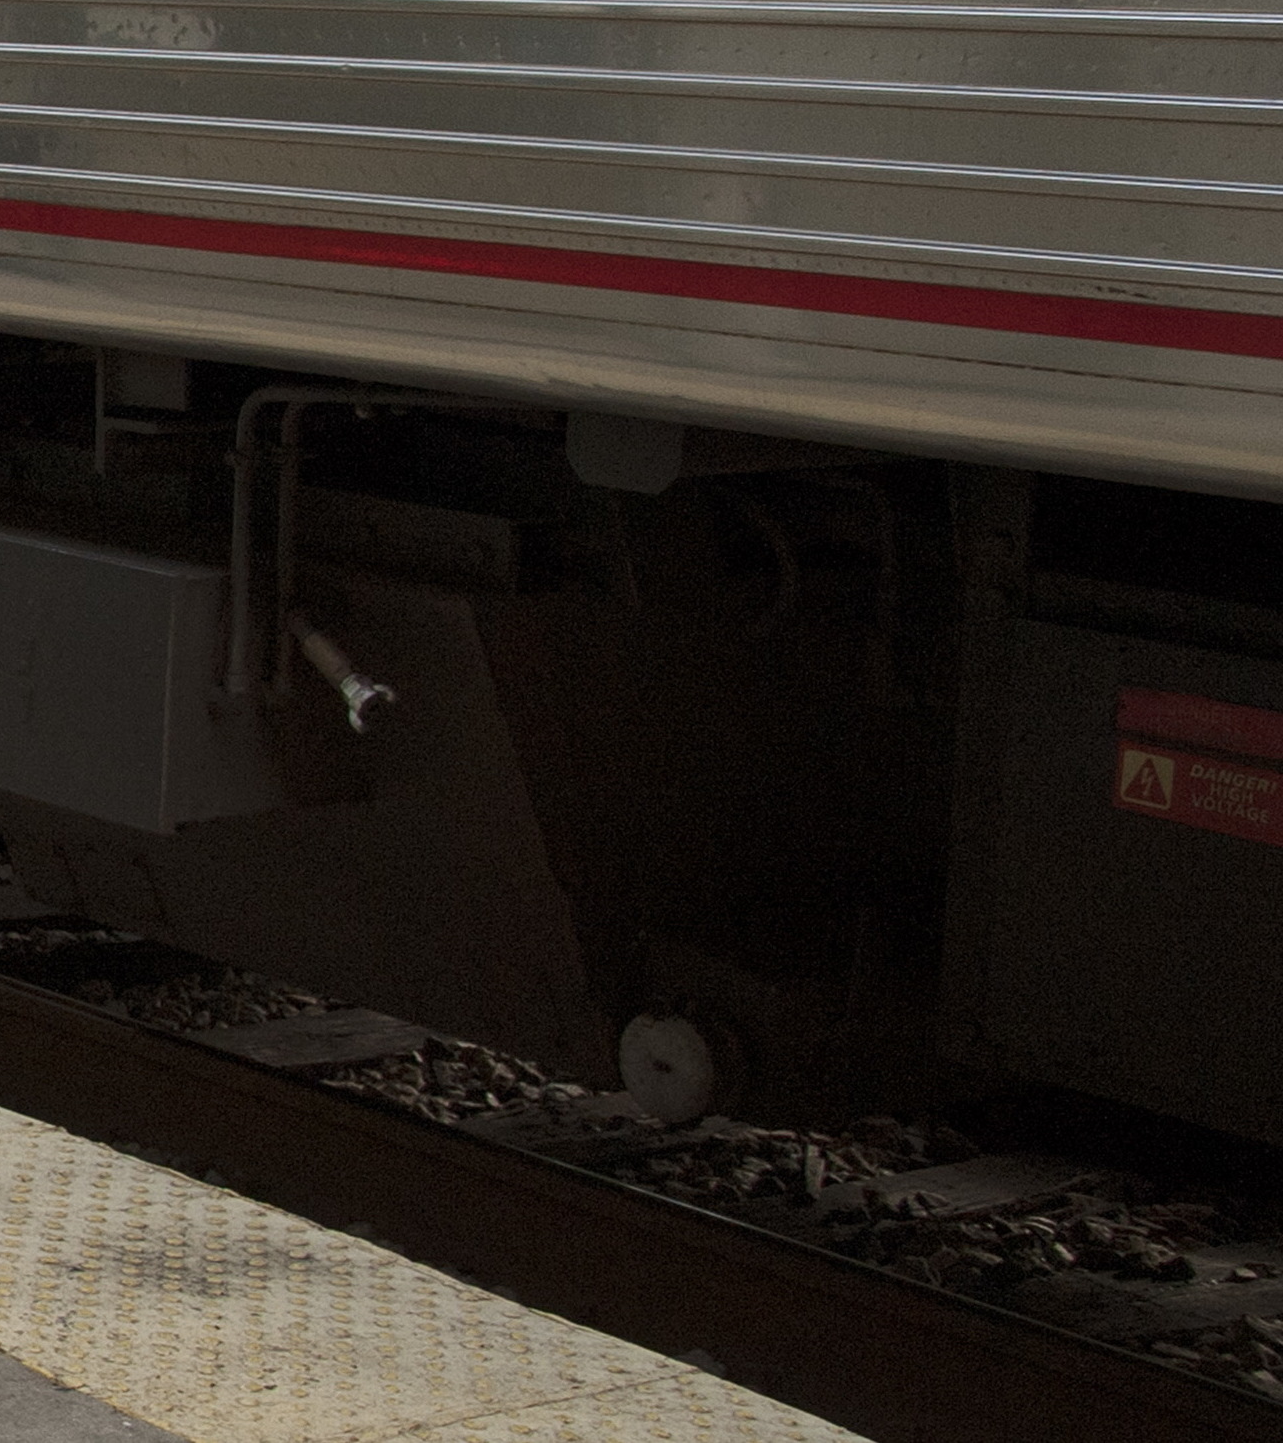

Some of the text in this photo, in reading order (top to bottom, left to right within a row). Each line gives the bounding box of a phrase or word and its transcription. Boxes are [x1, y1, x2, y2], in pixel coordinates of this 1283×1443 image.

[1189, 764, 1279, 795] DANGER!
[1210, 783, 1254, 804] HIGH
[1191, 794, 1271, 824] VOLTAGE
